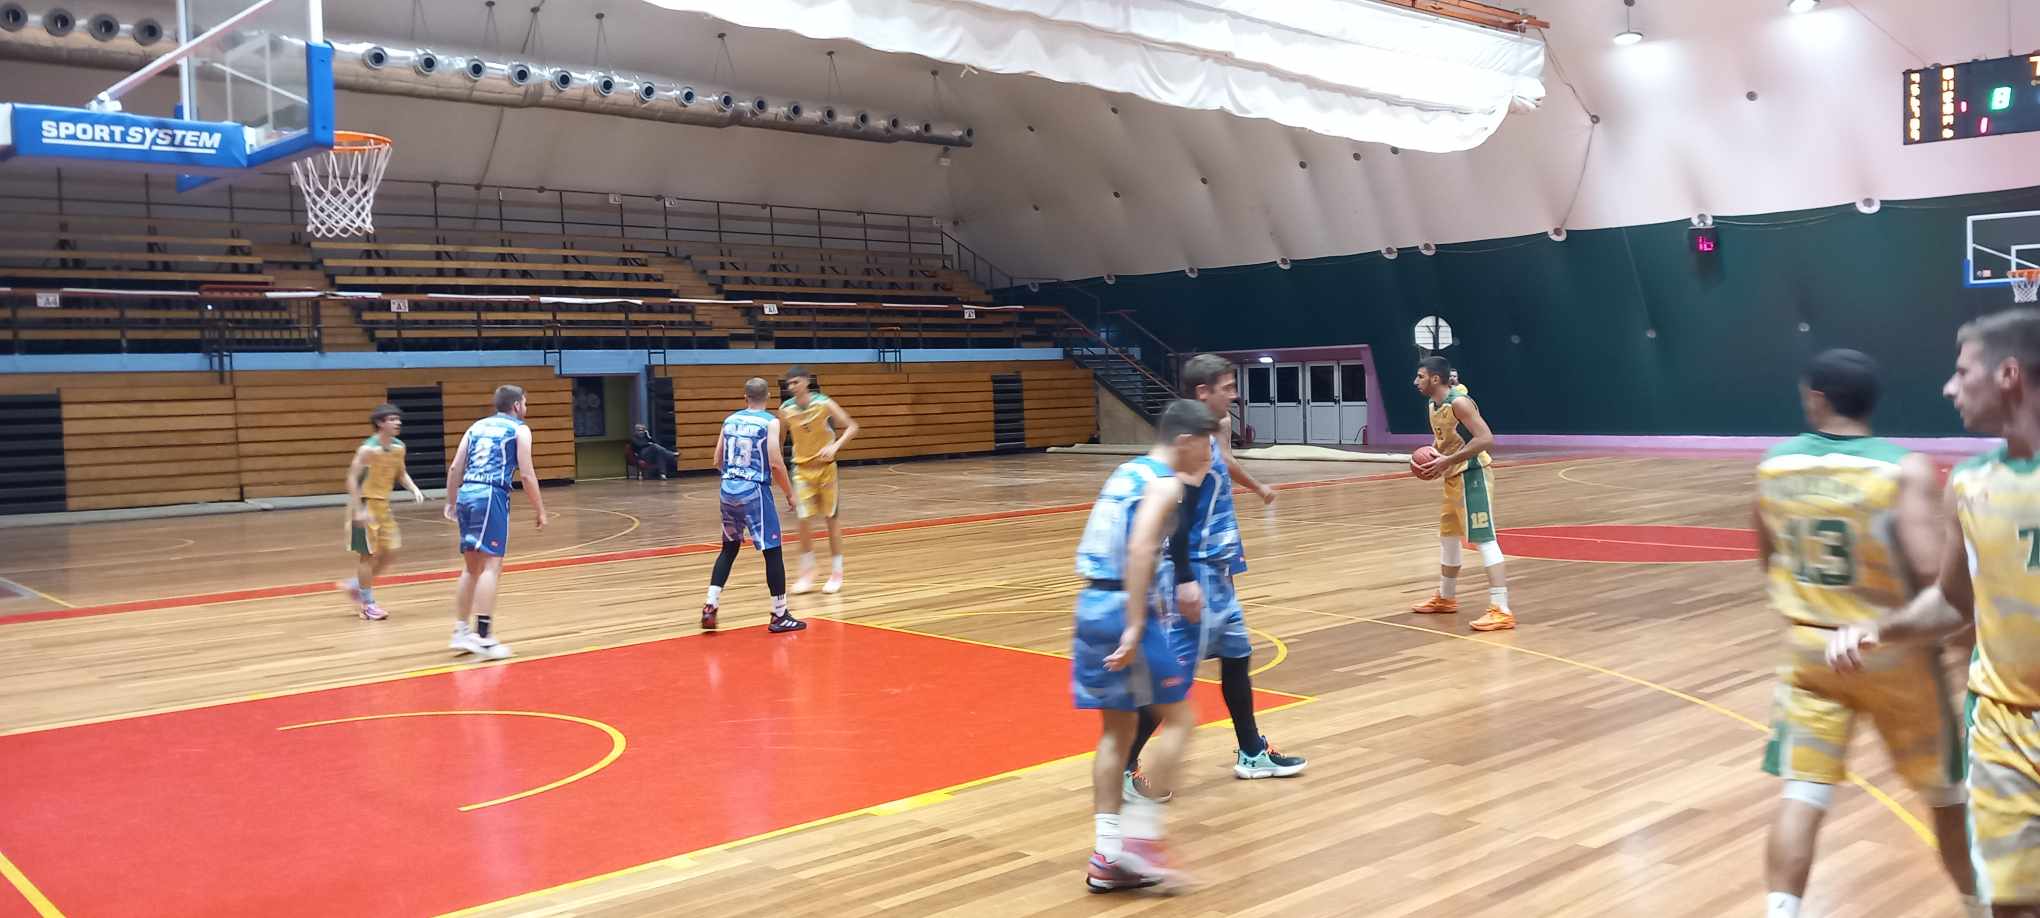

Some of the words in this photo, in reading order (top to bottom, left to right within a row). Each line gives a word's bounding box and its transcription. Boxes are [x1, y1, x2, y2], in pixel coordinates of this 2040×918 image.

[41, 119, 125, 143] SPORT
[126, 126, 222, 149] SYSTEM
[728, 437, 752, 467] 13
[1470, 511, 1489, 529] 12
